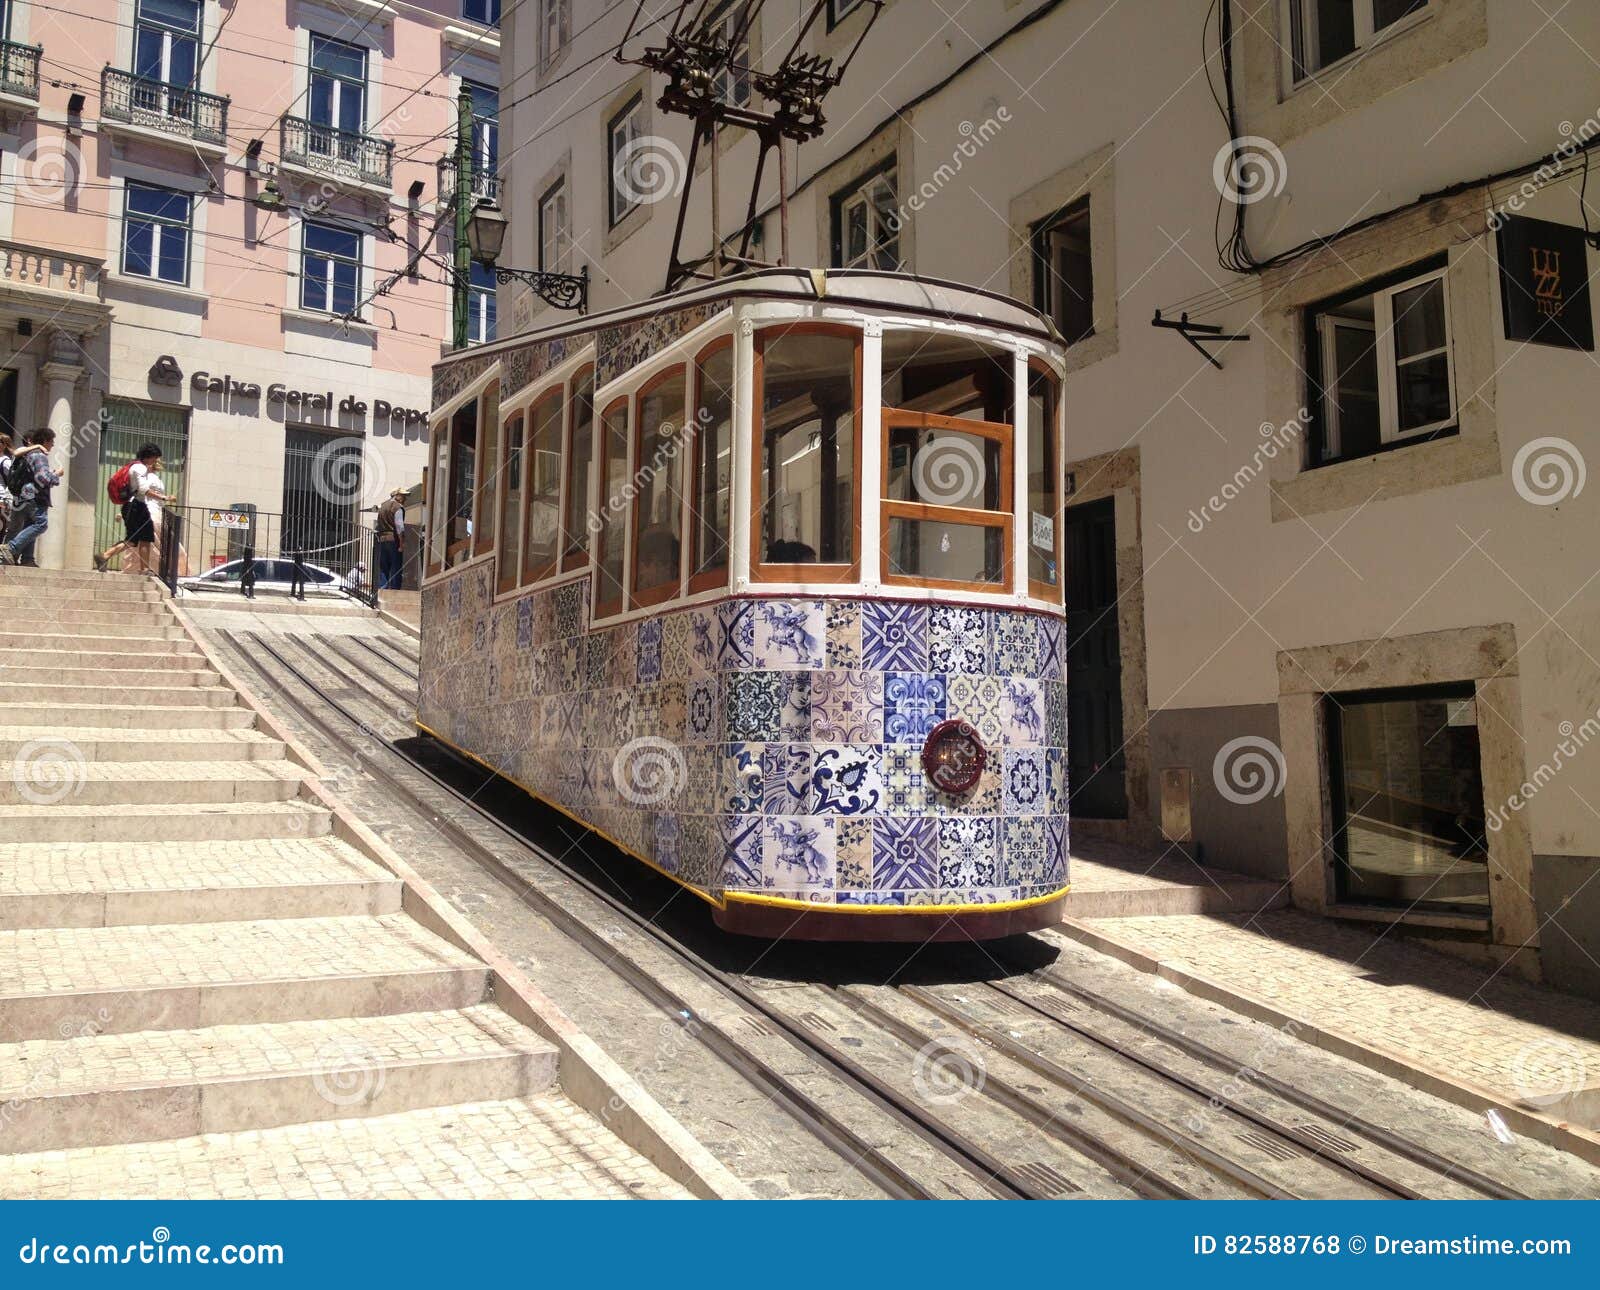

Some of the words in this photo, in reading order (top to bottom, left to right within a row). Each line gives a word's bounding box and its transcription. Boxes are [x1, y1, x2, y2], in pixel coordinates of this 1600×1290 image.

[190, 371, 261, 400] Caixa
[266, 383, 333, 411] Geral
[338, 395, 368, 416] de
